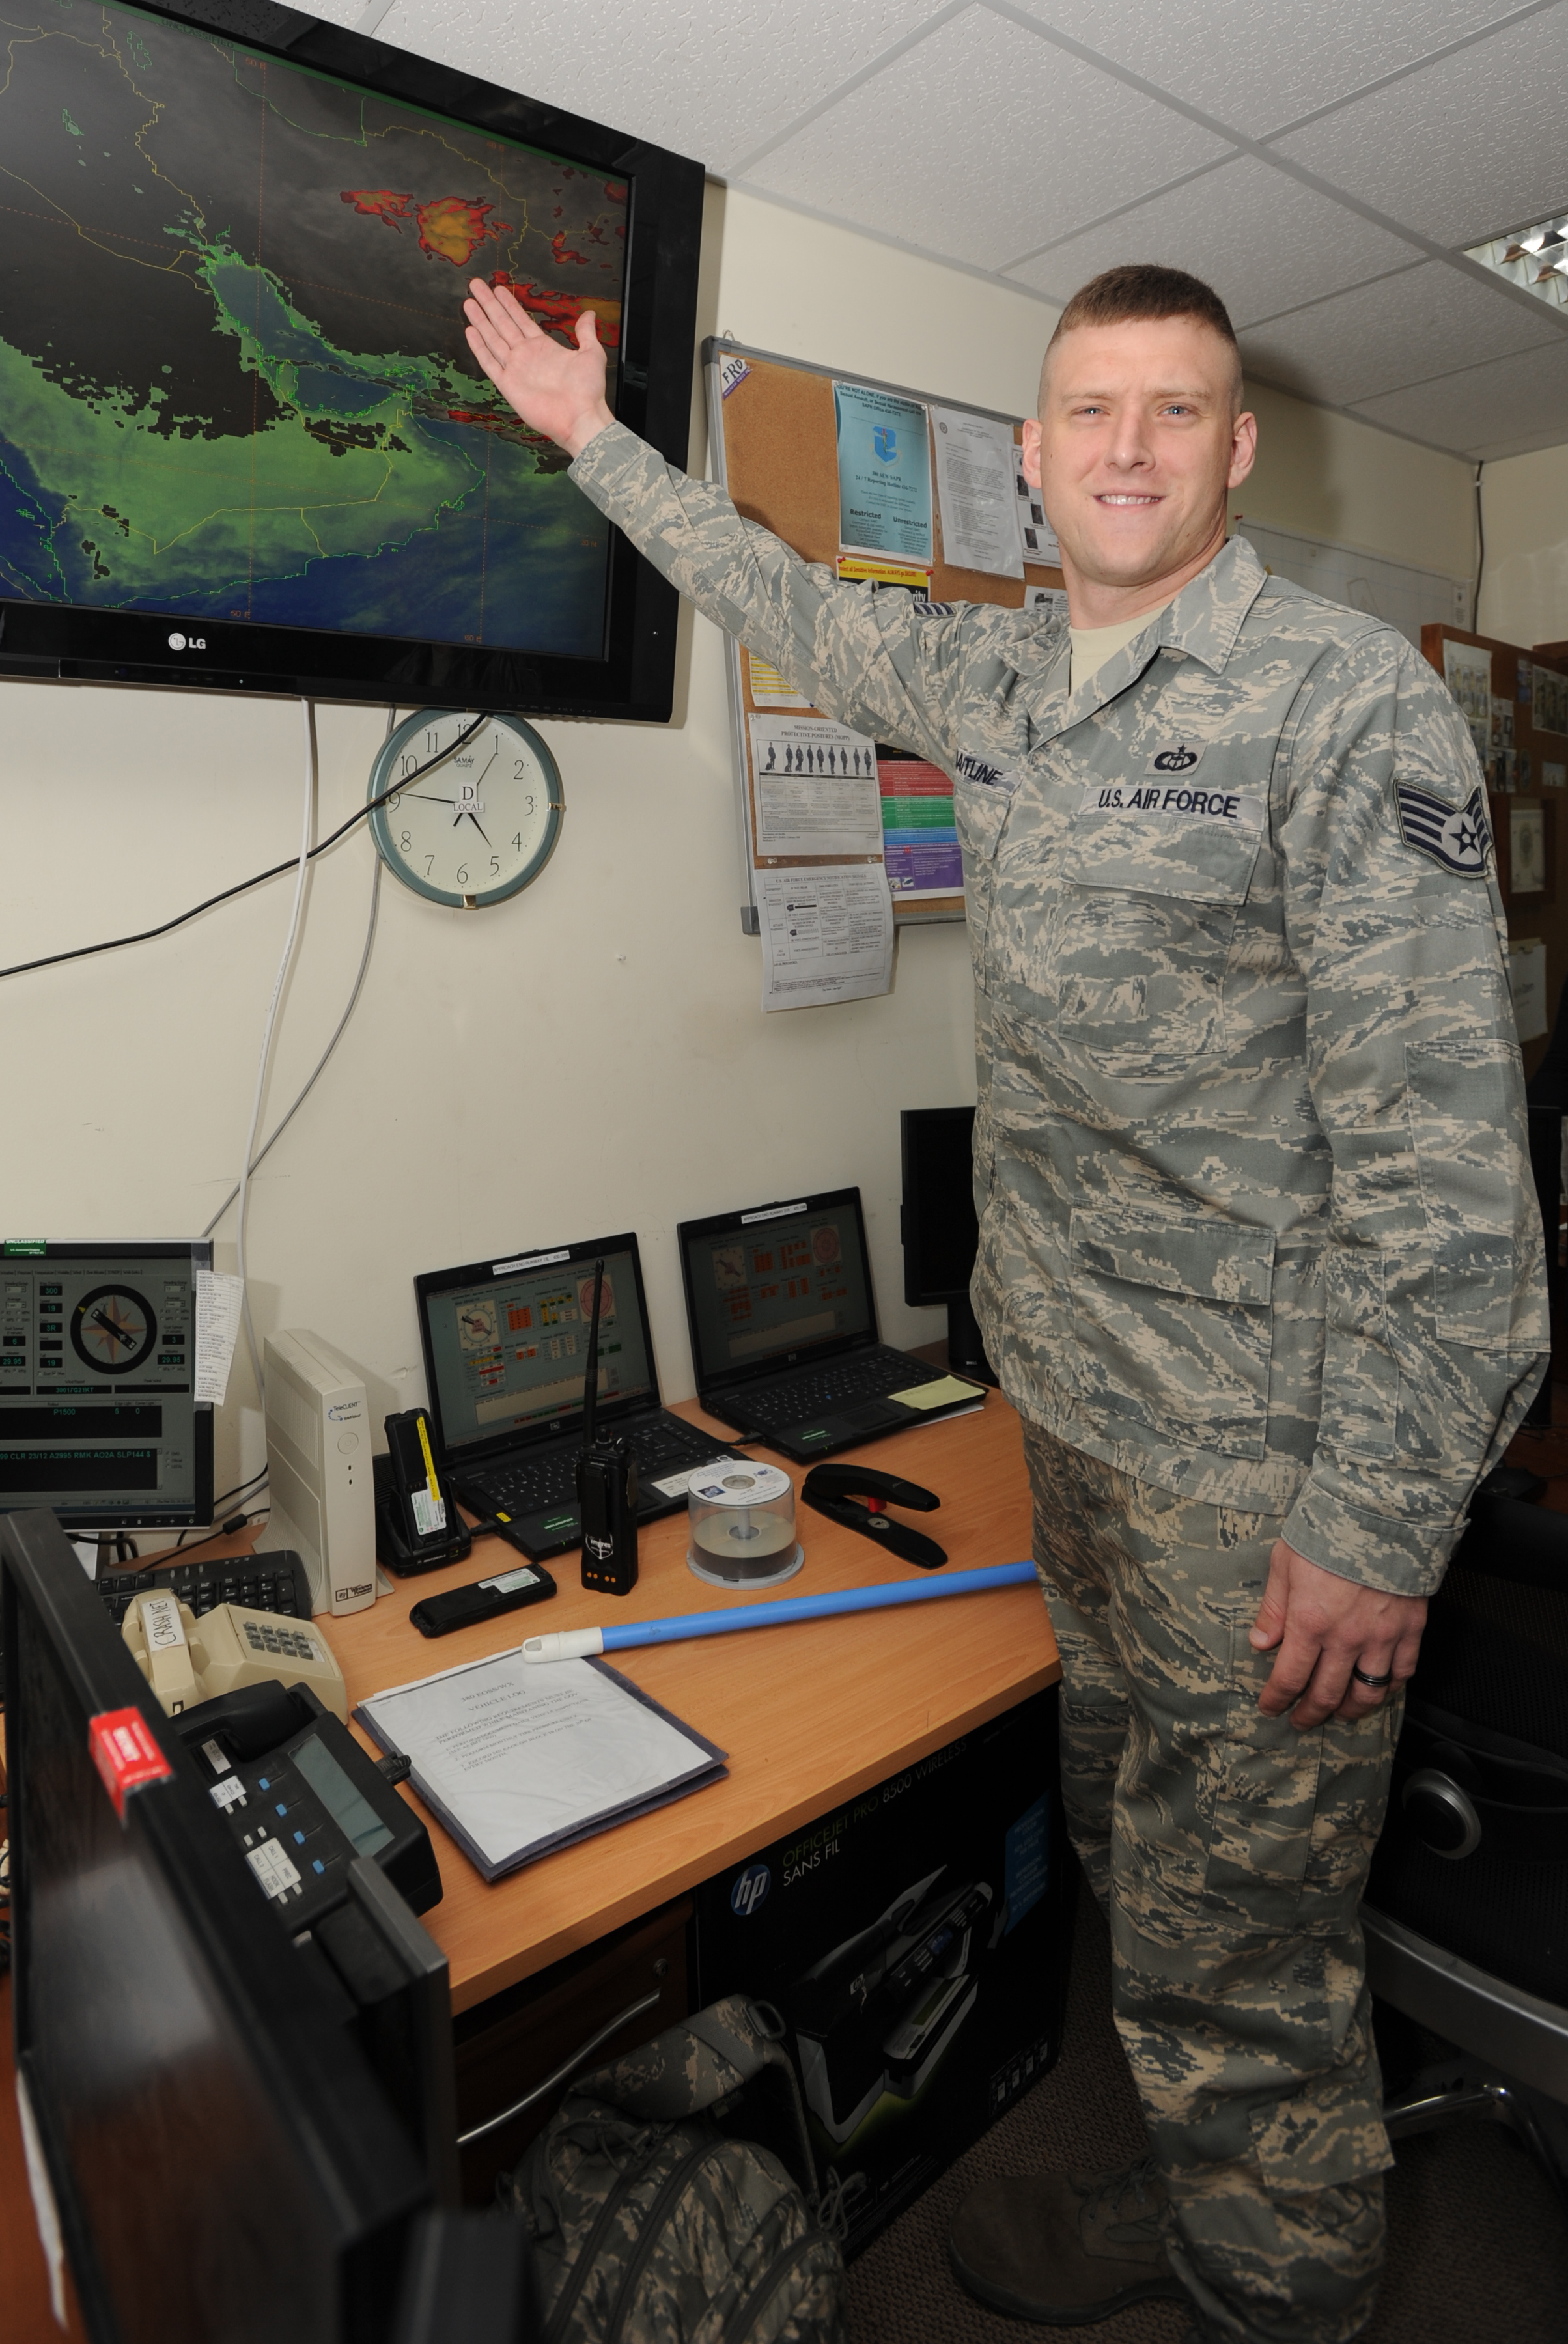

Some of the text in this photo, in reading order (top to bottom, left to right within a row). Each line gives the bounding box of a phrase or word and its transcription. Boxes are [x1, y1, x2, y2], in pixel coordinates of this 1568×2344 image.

[161, 18, 234, 49] UNCLASSIFIED
[722, 359, 743, 384] FRD
[867, 477, 886, 487] Reporting
[850, 509, 882, 520] Restricted
[893, 516, 927, 529] Unrestricted
[188, 637, 206, 649] LG
[794, 725, 838, 733] MISSION-ORIENTED
[426, 731, 439, 753] 11
[494, 734, 499, 755] 1
[513, 759, 524, 780] 2
[388, 791, 401, 813] 9
[462, 786, 474, 801] D
[1098, 788, 1240, 819] U.S. AIR FORCE
[453, 802, 483, 812] LOCAL
[524, 795, 534, 816] 3
[400, 830, 412, 852] 8
[511, 831, 522, 852] 4
[424, 854, 435, 876] 7
[456, 862, 469, 884] 6
[489, 856, 500, 877] 5
[494, 1264, 516, 1272] APPROACH
[27, 1451, 48, 1460] 23/12
[49, 1451, 72, 1459] A2995
[146, 1449, 150, 1458] $
[149, 1600, 176, 1645] CRASH NET
[460, 1681, 514, 1703] 380 EOSS/WX
[468, 1689, 527, 1712] VEHICLE LOG
[436, 1732, 450, 1741] THE
[450, 1716, 493, 1735] FOLLOWING
[493, 1699, 541, 1720] REQUIREMENTS
[542, 1692, 565, 1703] MUST
[439, 1725, 482, 1745] PERFORMED
[482, 1716, 506, 1727] WHILE
[550, 1695, 563, 1705] THE
[461, 1746, 489, 1758] PERFORM
[464, 1761, 484, 1772] EVERY
[782, 1736, 968, 1868] OFFICEJET PRO 8500 WIRELESS
[782, 1838, 841, 1888] SANS FIL
[734, 1869, 768, 1914] hp
